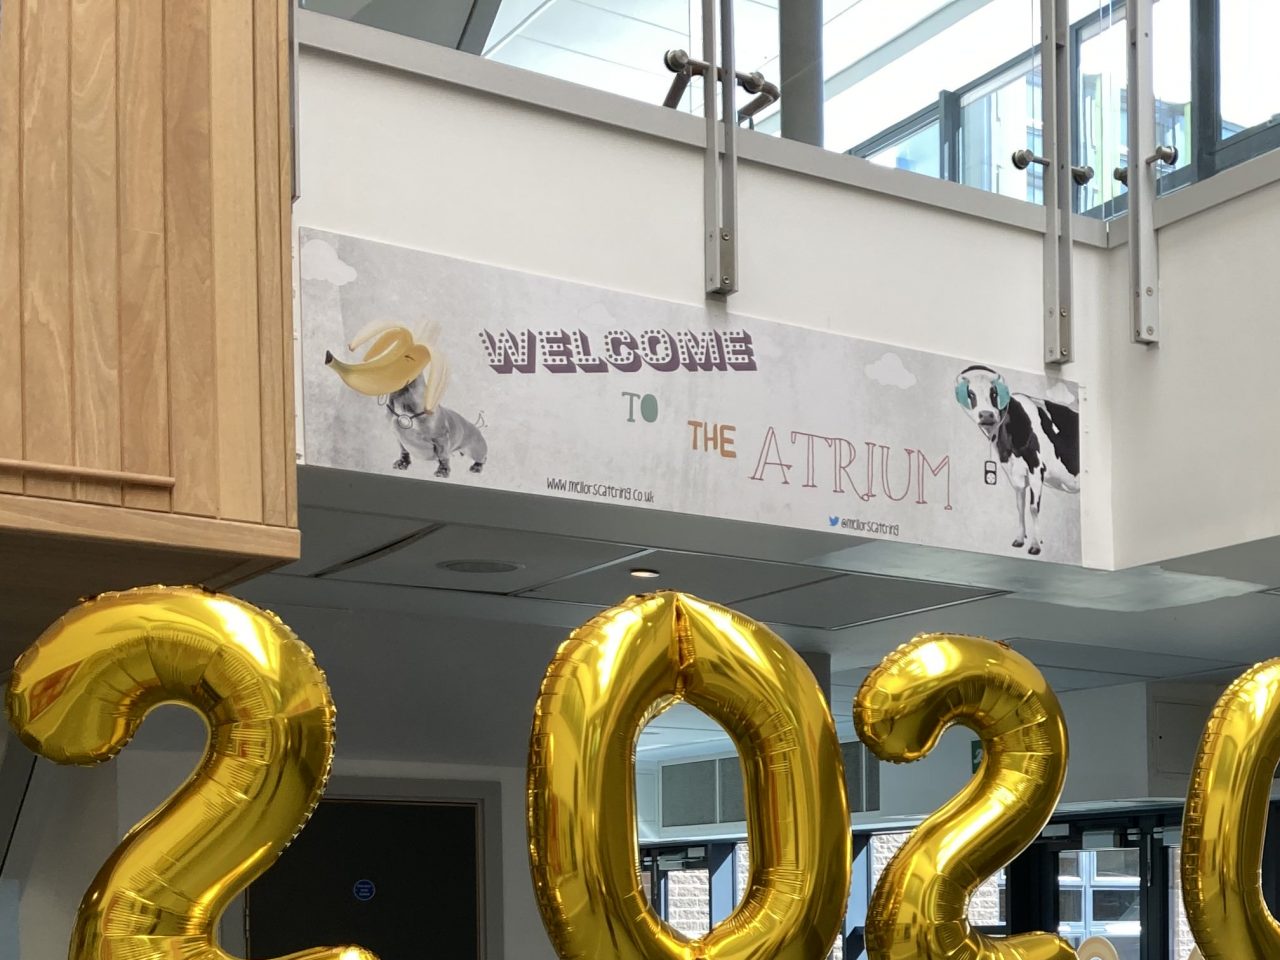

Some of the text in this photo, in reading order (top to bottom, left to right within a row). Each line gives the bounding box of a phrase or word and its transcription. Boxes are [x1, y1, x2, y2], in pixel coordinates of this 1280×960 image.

[478, 328, 757, 374] WELCOME
[622, 391, 658, 423] TO
[688, 420, 953, 511] THE ATRIUM
